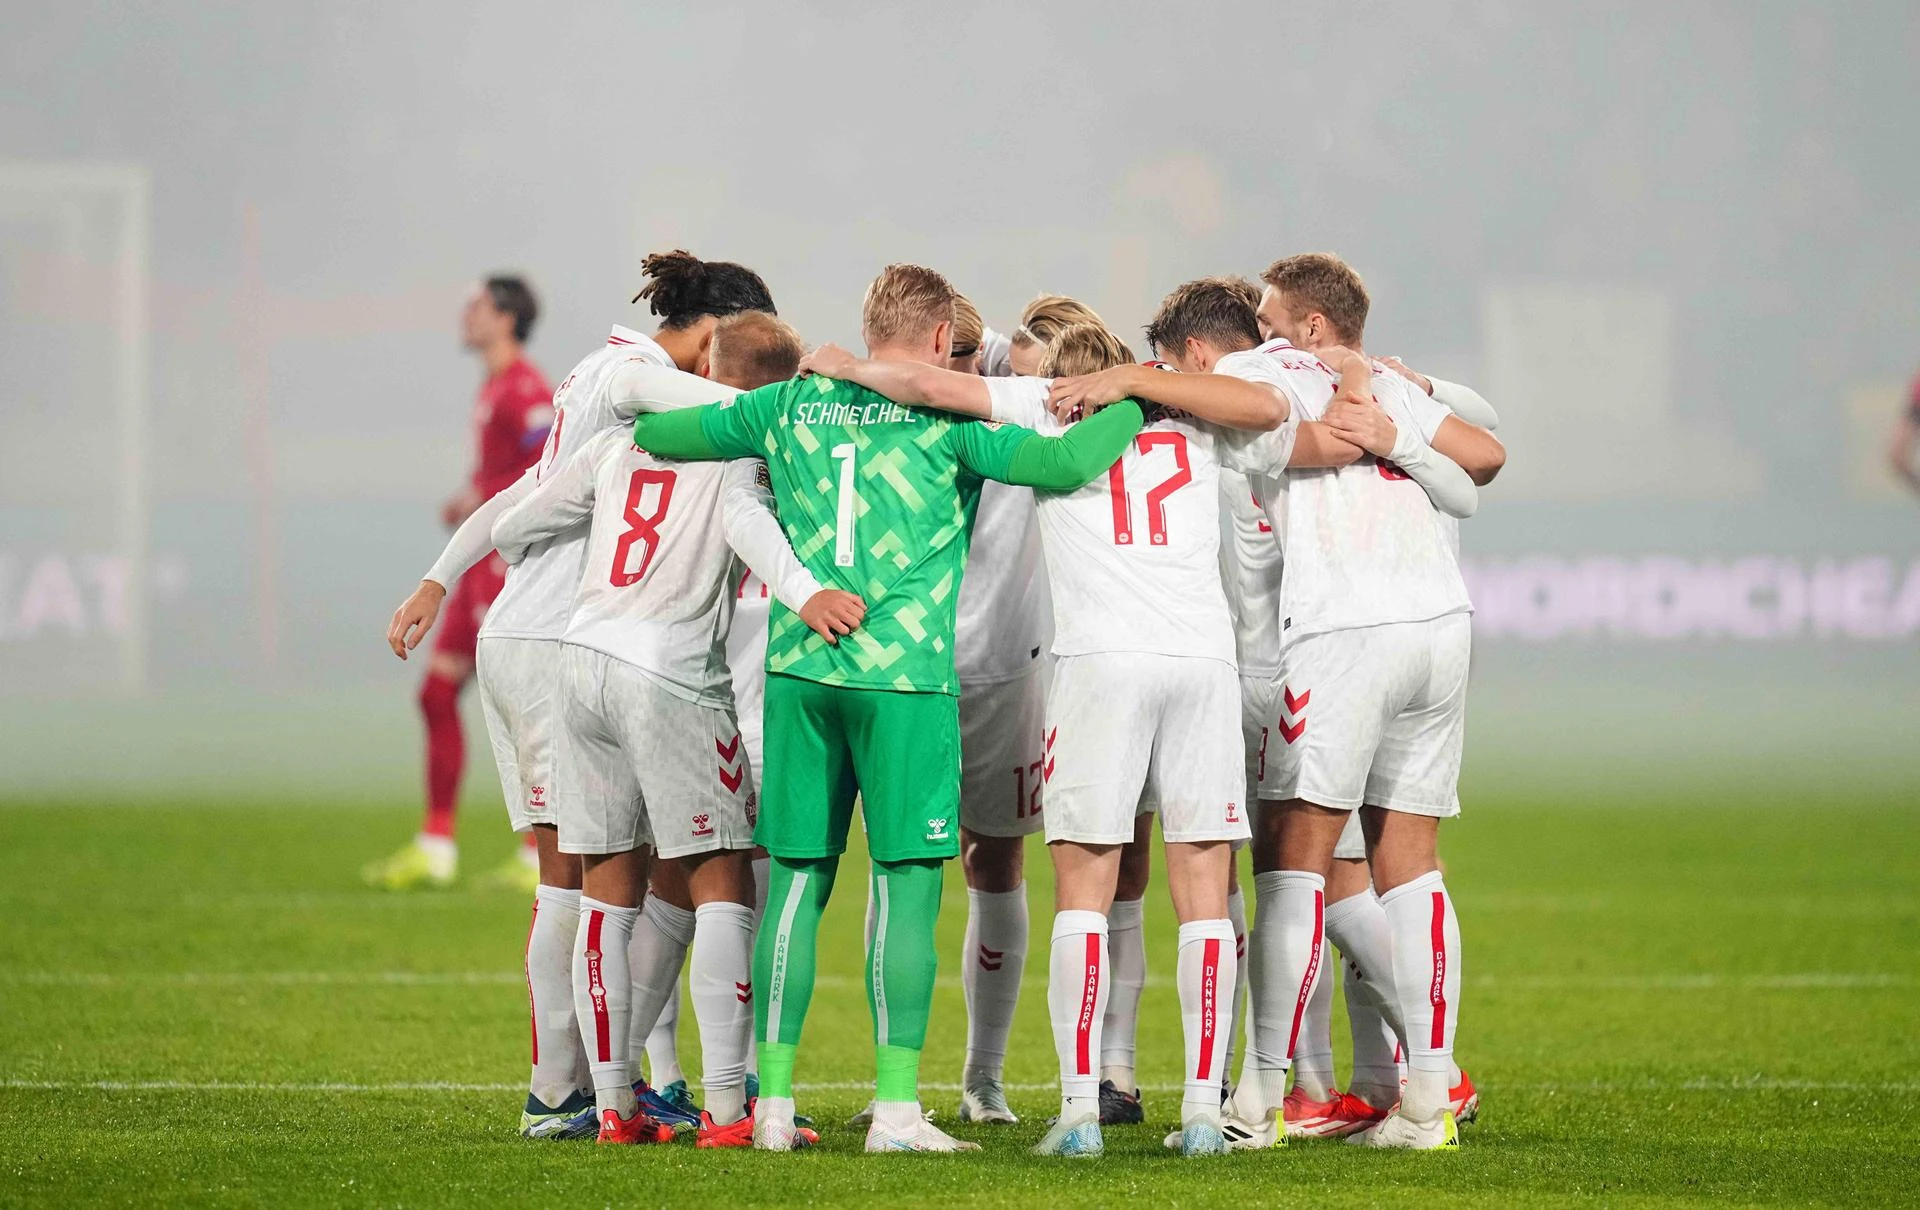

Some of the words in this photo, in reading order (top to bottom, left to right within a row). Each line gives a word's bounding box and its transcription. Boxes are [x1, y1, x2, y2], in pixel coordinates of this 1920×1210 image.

[793, 402, 917, 427] SCHMEICHEL
[831, 442, 856, 567] 1
[1108, 431, 1192, 546] 17
[609, 468, 678, 588] 8
[1013, 759, 1043, 819] 12
[772, 934, 787, 1002] DANMARK
[1080, 965, 1097, 1031] DANMARK
[1204, 966, 1214, 1038] DANMARK
